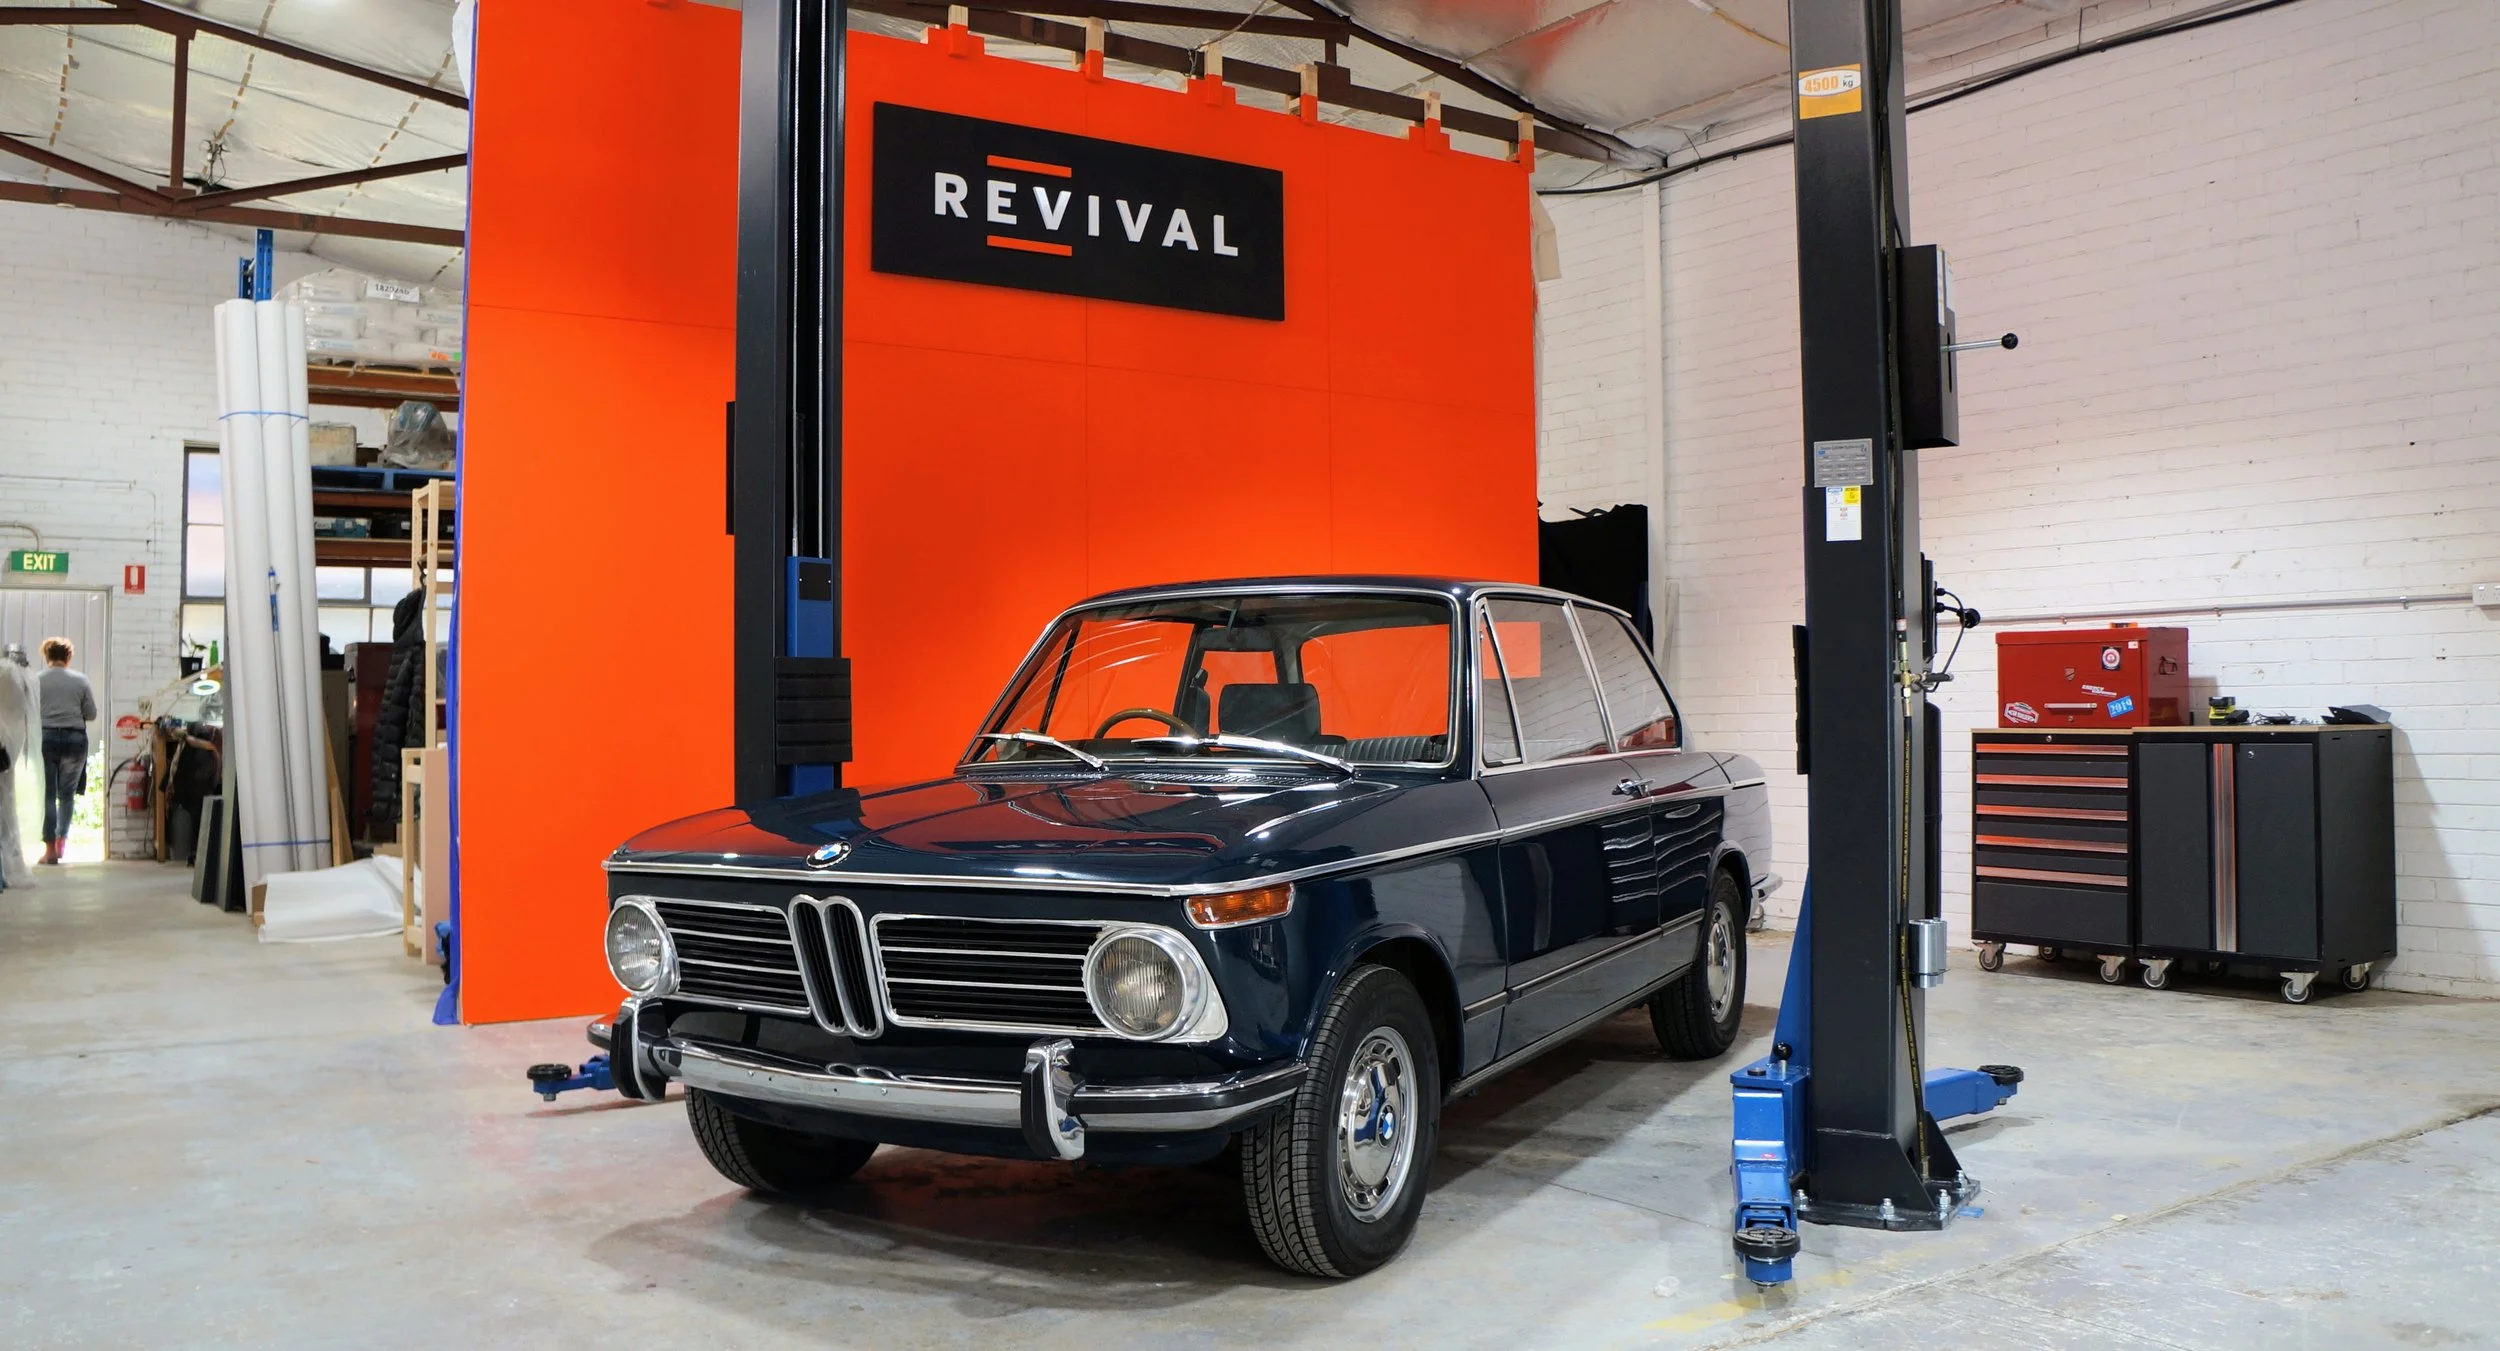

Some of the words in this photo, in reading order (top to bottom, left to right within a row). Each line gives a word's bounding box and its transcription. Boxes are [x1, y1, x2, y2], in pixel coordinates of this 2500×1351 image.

[1804, 75, 1839, 93] 4500
[1843, 79, 1854, 88] kg
[933, 171, 1239, 257] REVIVAL
[23, 553, 56, 571] EXIT
[2110, 697, 2132, 715] 2019
